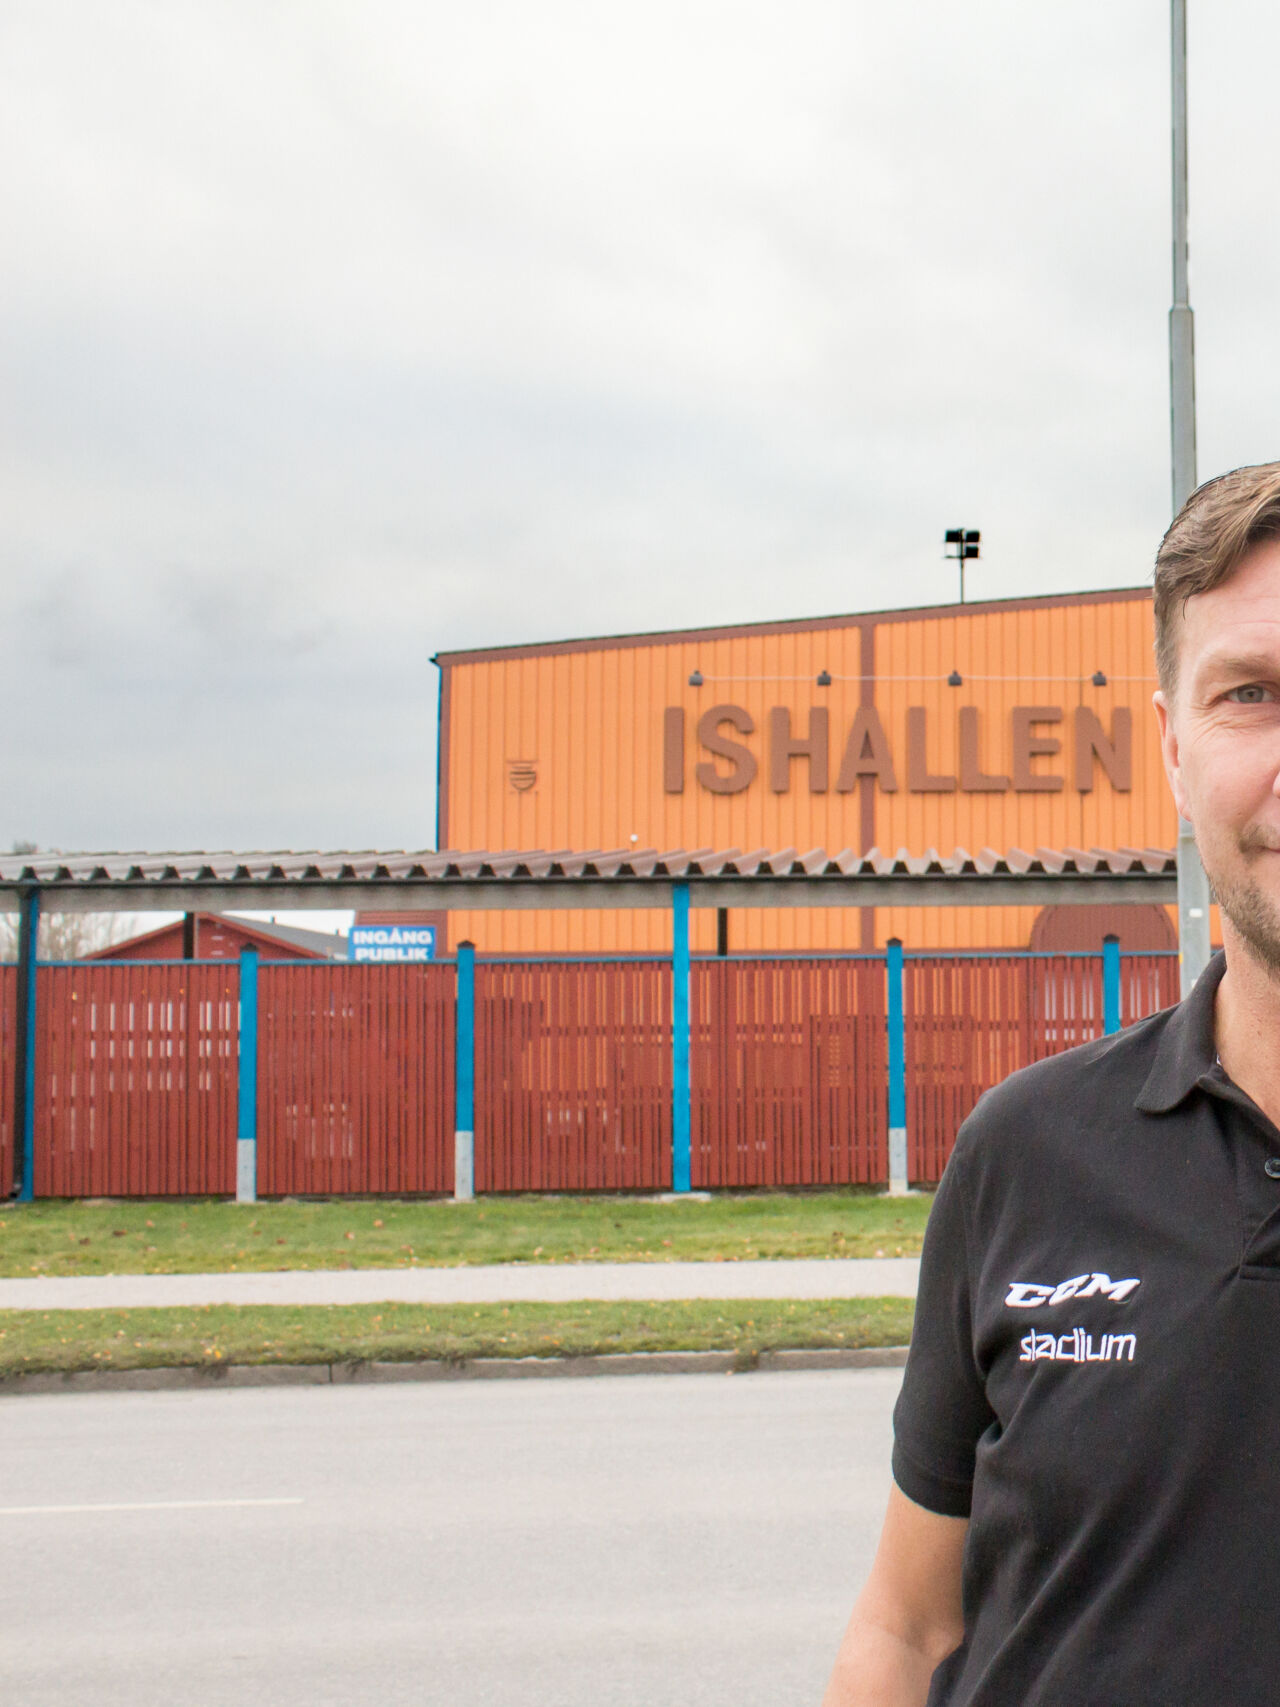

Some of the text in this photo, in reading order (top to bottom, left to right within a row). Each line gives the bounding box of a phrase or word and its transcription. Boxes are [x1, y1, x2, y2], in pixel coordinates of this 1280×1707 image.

[664, 704, 1133, 794] ISHALLEN
[353, 927, 432, 944] INGÅNG
[355, 948, 428, 960] PUBLIK
[1005, 1272, 1141, 1308] CCM
[1019, 1327, 1137, 1363] stadium
